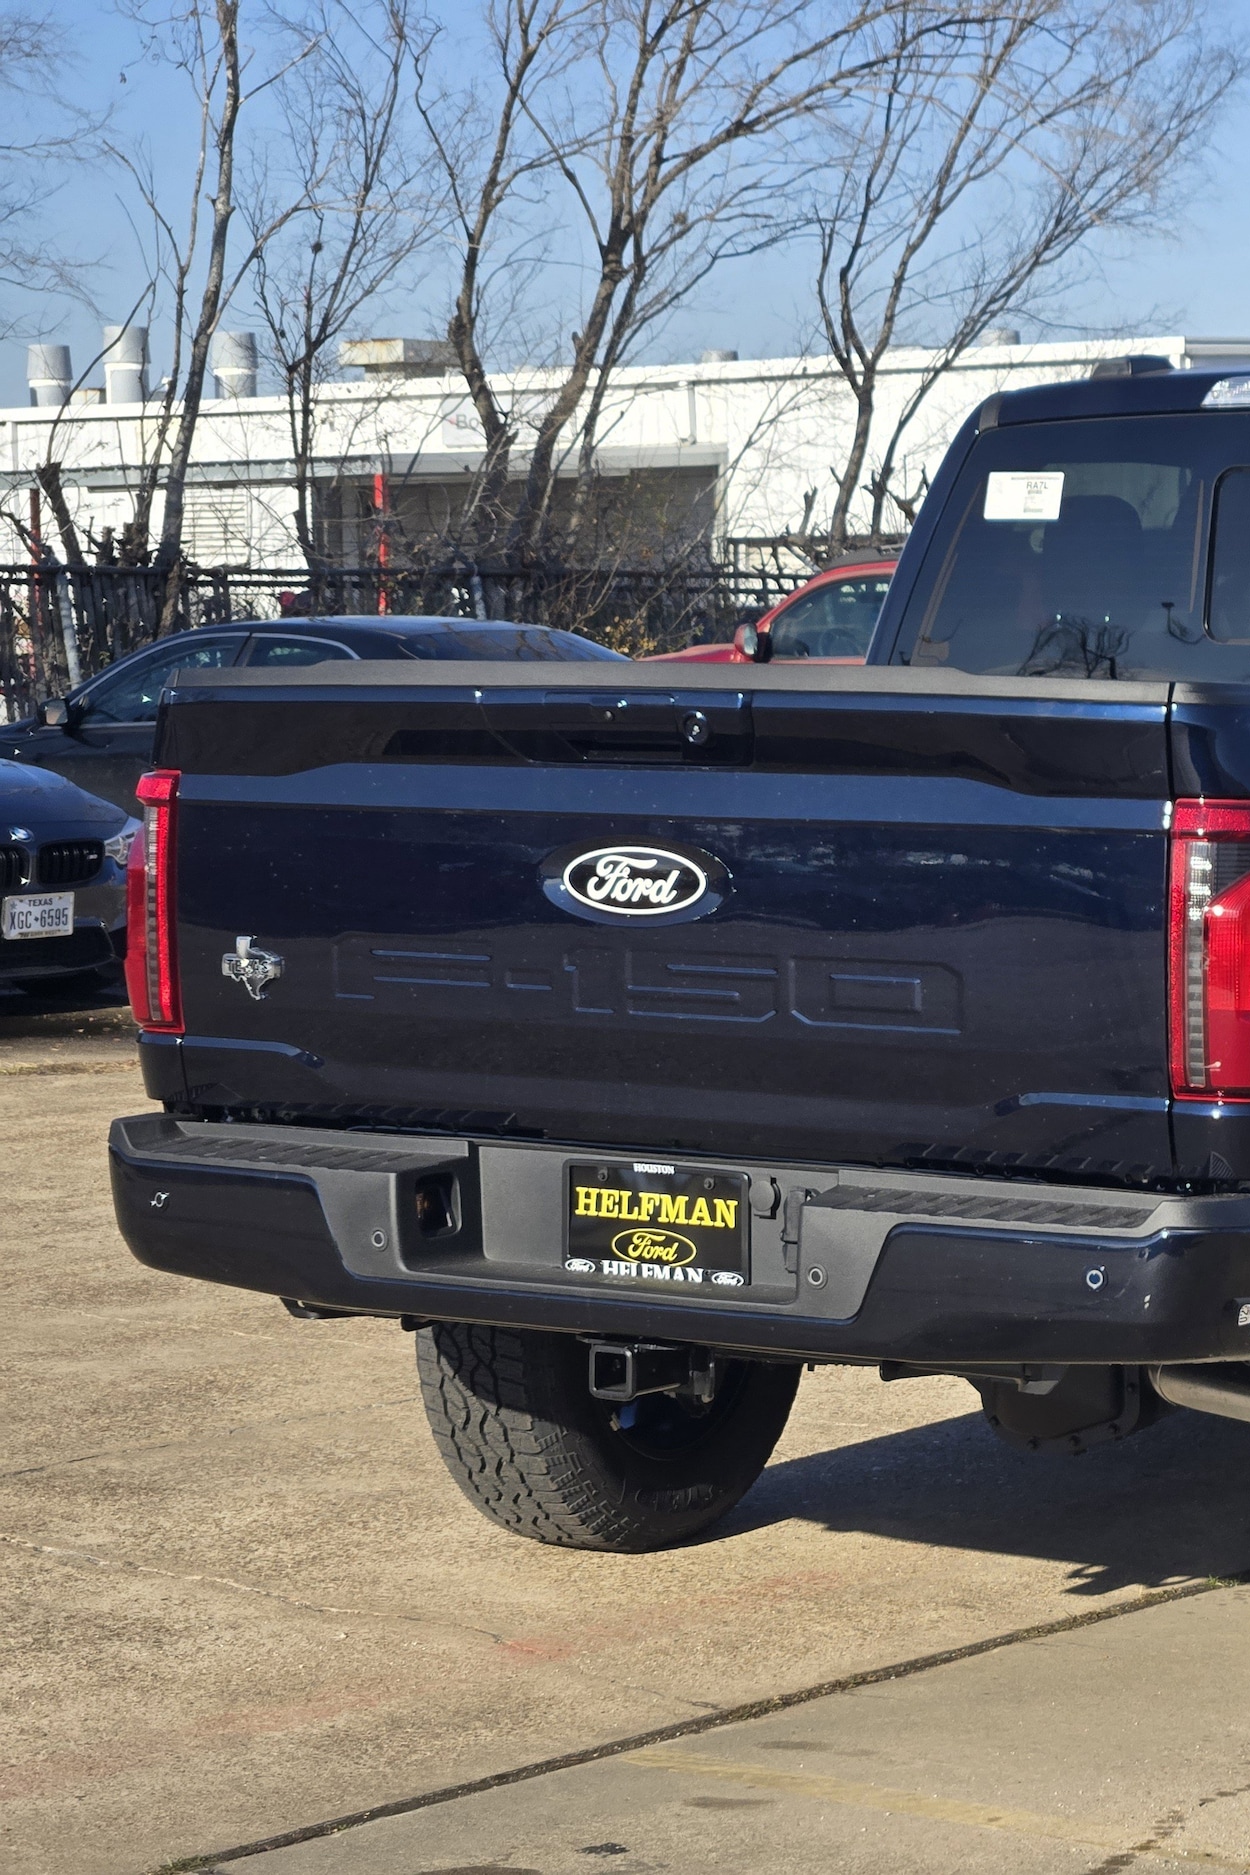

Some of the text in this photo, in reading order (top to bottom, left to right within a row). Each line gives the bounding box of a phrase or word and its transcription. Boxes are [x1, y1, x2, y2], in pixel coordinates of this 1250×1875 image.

[587, 855, 681, 904] Ford
[27, 898, 53, 907] TEXAS
[332, 931, 964, 1034] F-150
[633, 1163, 675, 1175] HOUSTON
[575, 1187, 738, 1229] HELFMAN
[628, 1232, 679, 1262] Ford
